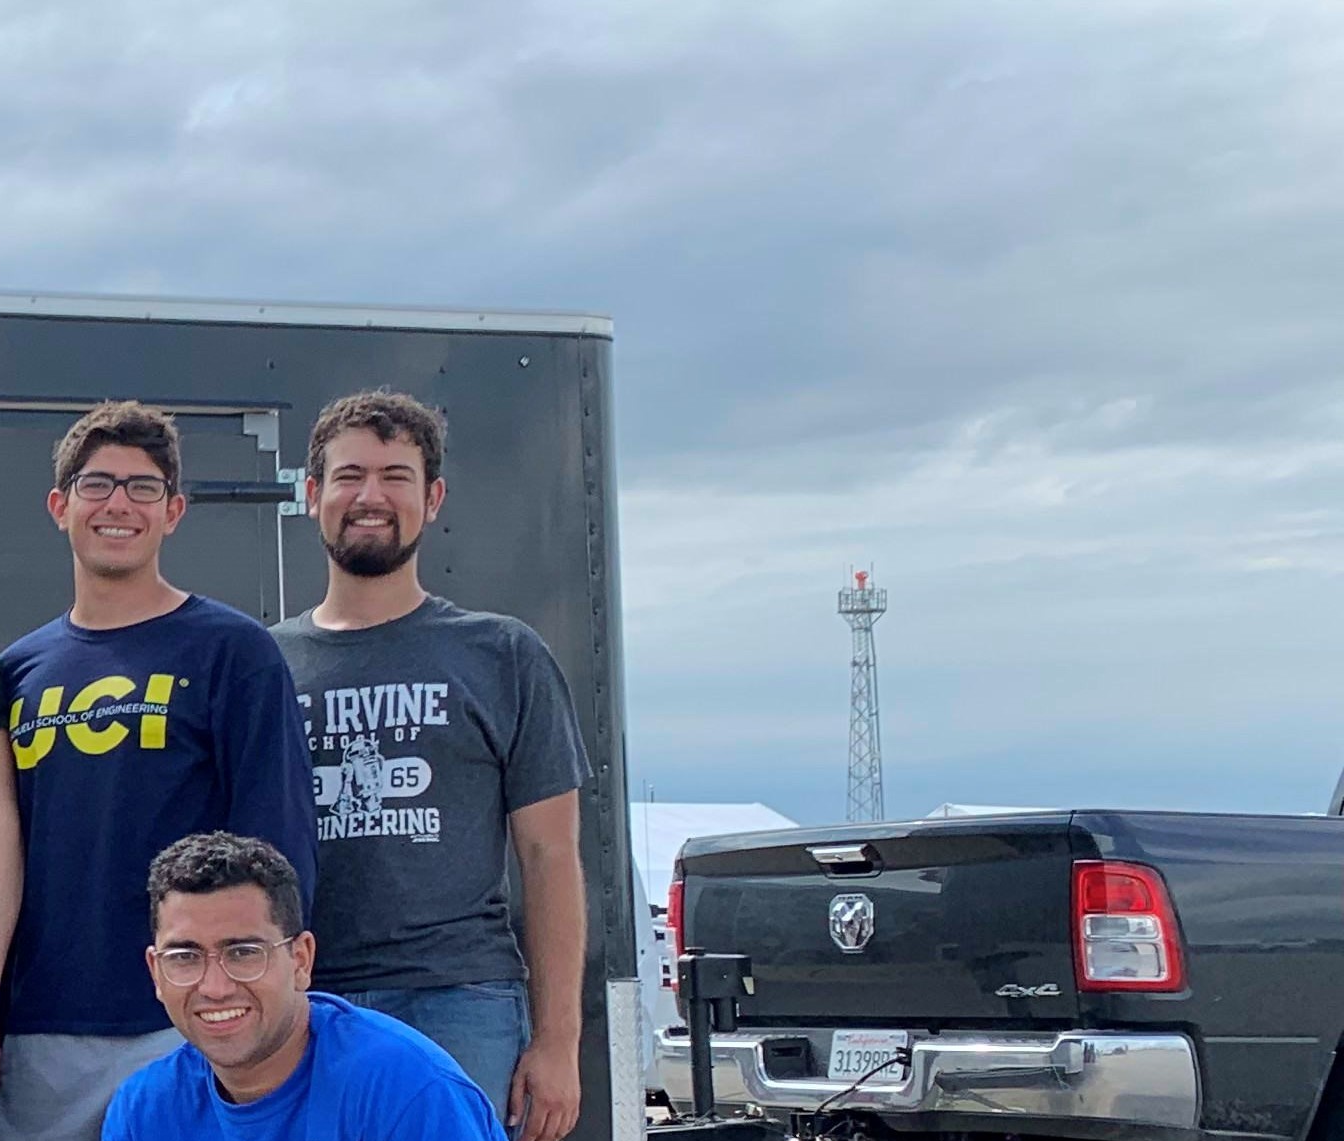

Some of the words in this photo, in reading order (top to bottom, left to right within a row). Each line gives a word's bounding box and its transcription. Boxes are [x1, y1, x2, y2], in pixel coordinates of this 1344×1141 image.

[36, 714, 79, 728] SCHOOL
[80, 711, 95, 722] OF
[95, 702, 168, 719] ENGINEERING
[324, 682, 449, 734] IRVINE
[9, 673, 175, 770] UCI
[308, 732, 379, 751] CHOOL
[394, 726, 421, 742] OF
[390, 766, 419, 788] 65
[317, 807, 440, 841] INEERING
[994, 983, 1064, 998] 4x4
